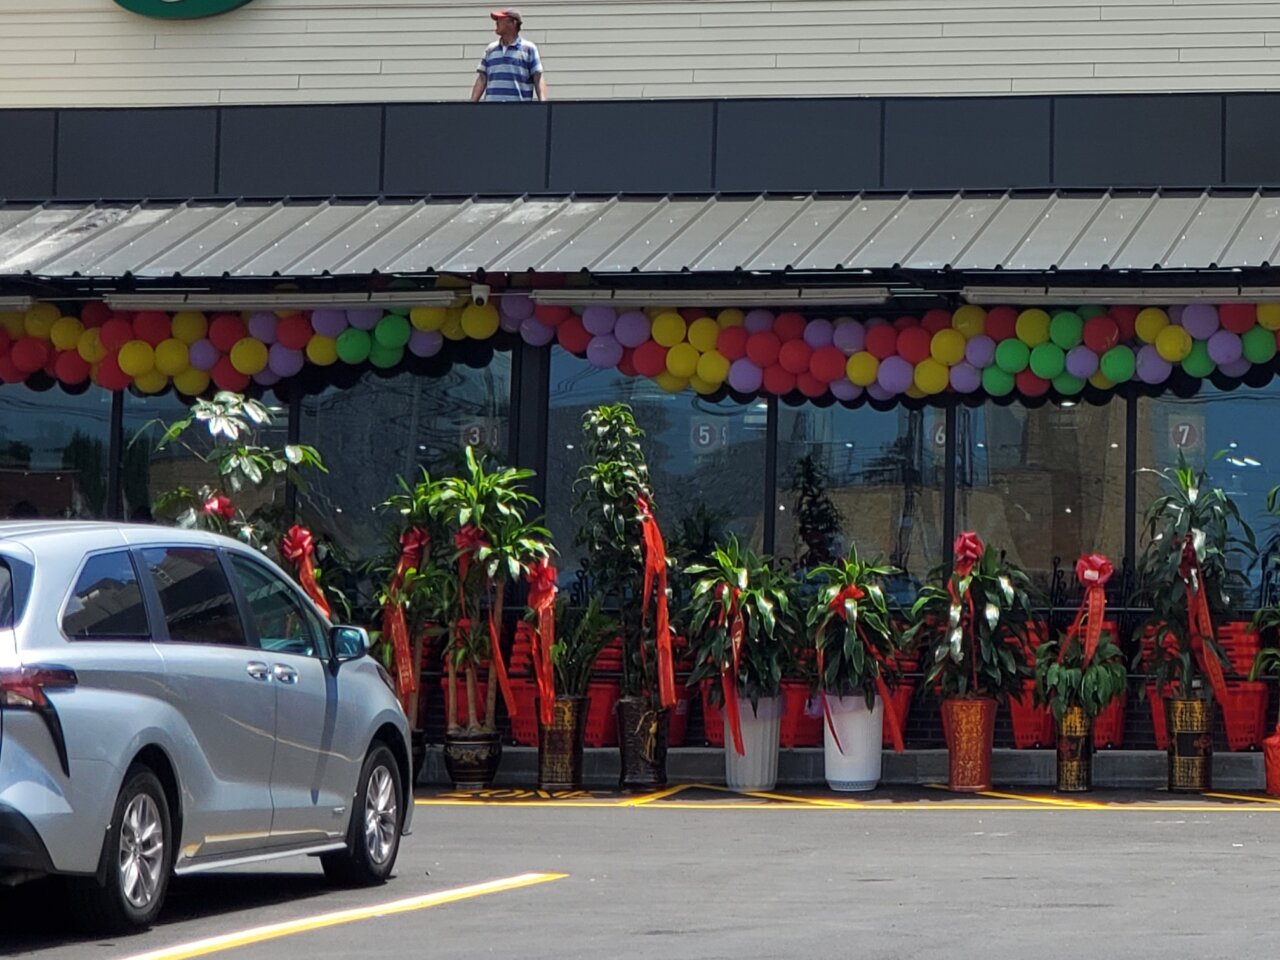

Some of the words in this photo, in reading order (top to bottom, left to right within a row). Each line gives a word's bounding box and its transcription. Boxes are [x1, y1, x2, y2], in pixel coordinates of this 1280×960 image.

[469, 426, 480, 445] 3
[699, 425, 710, 445] 5
[935, 425, 946, 444] 6
[1178, 425, 1190, 445] 7
